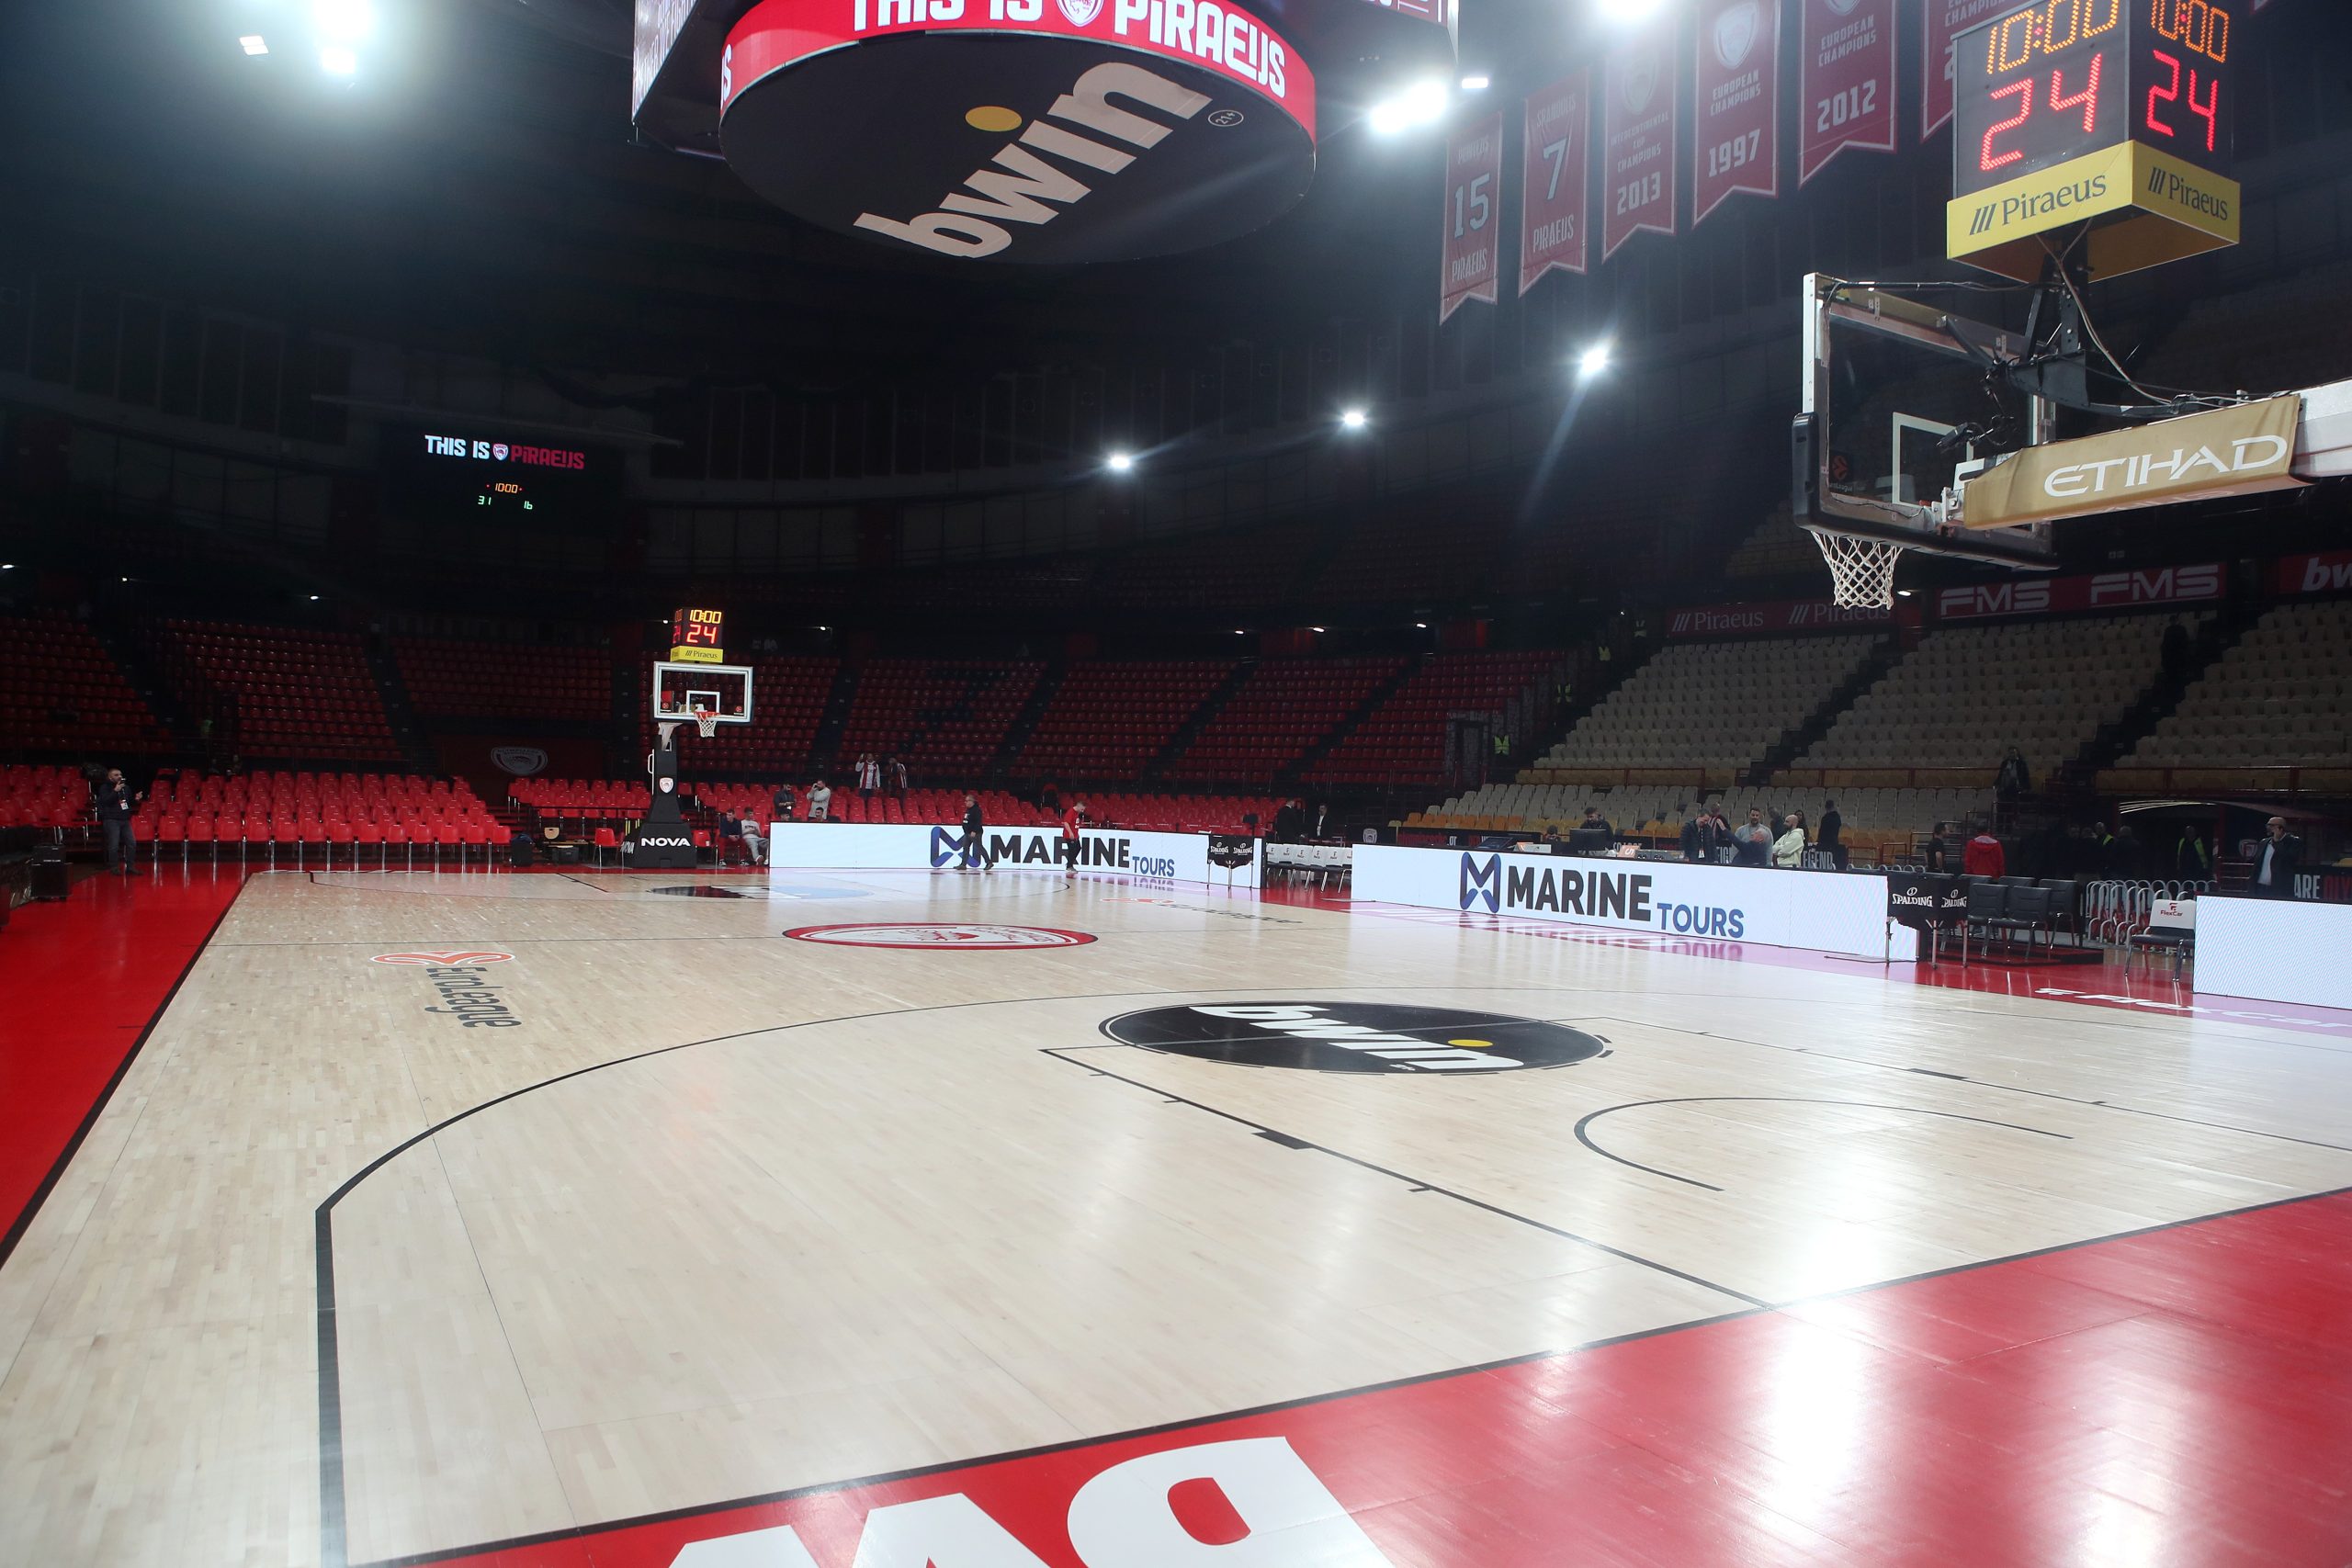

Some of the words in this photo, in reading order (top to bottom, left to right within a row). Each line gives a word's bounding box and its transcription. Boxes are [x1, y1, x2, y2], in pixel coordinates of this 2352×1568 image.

[1820, 15, 1875, 51] EUROPEAN
[1944, 0, 2006, 28] CHAMPIO
[1818, 29, 1877, 68] CHAMPIONS
[1986, 0, 2119, 74] 10:00
[1710, 83, 1761, 117] CHAMPIONS
[1713, 69, 1759, 101] EUROPEAN
[2147, 50, 2219, 152] 24
[1816, 79, 1877, 133] 2012
[1979, 52, 2102, 172] 24
[853, 62, 1213, 258] bwin
[1543, 138, 1567, 200] 7
[1617, 142, 1662, 174] CHAMPIONS
[1708, 129, 1761, 178] 1997
[1454, 173, 1490, 240] 15
[1617, 171, 1662, 216] 2013
[2001, 175, 2107, 226] Piraeus
[2168, 173, 2228, 221] Piraeus
[1532, 214, 1575, 254] PIRAEUS
[1451, 248, 1487, 283] PIRAEUS
[424, 434, 466, 457] THIS
[472, 440, 491, 459] IS
[2043, 434, 2289, 497] ETIHAD
[1940, 580, 2051, 617] FMS
[2090, 564, 2220, 604] FMS
[689, 609, 722, 625] 10:00
[1694, 611, 1765, 631] Piraeus
[1814, 603, 1892, 624] Piraeus
[686, 624, 718, 645] 24
[693, 650, 718, 660] Piraeus
[640, 837, 691, 847] NOVA
[990, 834, 1131, 868] MARINE
[1132, 855, 1176, 877] TOURS
[1507, 865, 1652, 922] MARINE
[1657, 902, 1745, 939] TOURS
[1892, 893, 1934, 908] SPALDING
[1940, 896, 1967, 908] SPALDING
[2294, 874, 2321, 899] ARE
[424, 966, 523, 1028] EuroLeague
[1188, 1005, 1525, 1070] bwin
